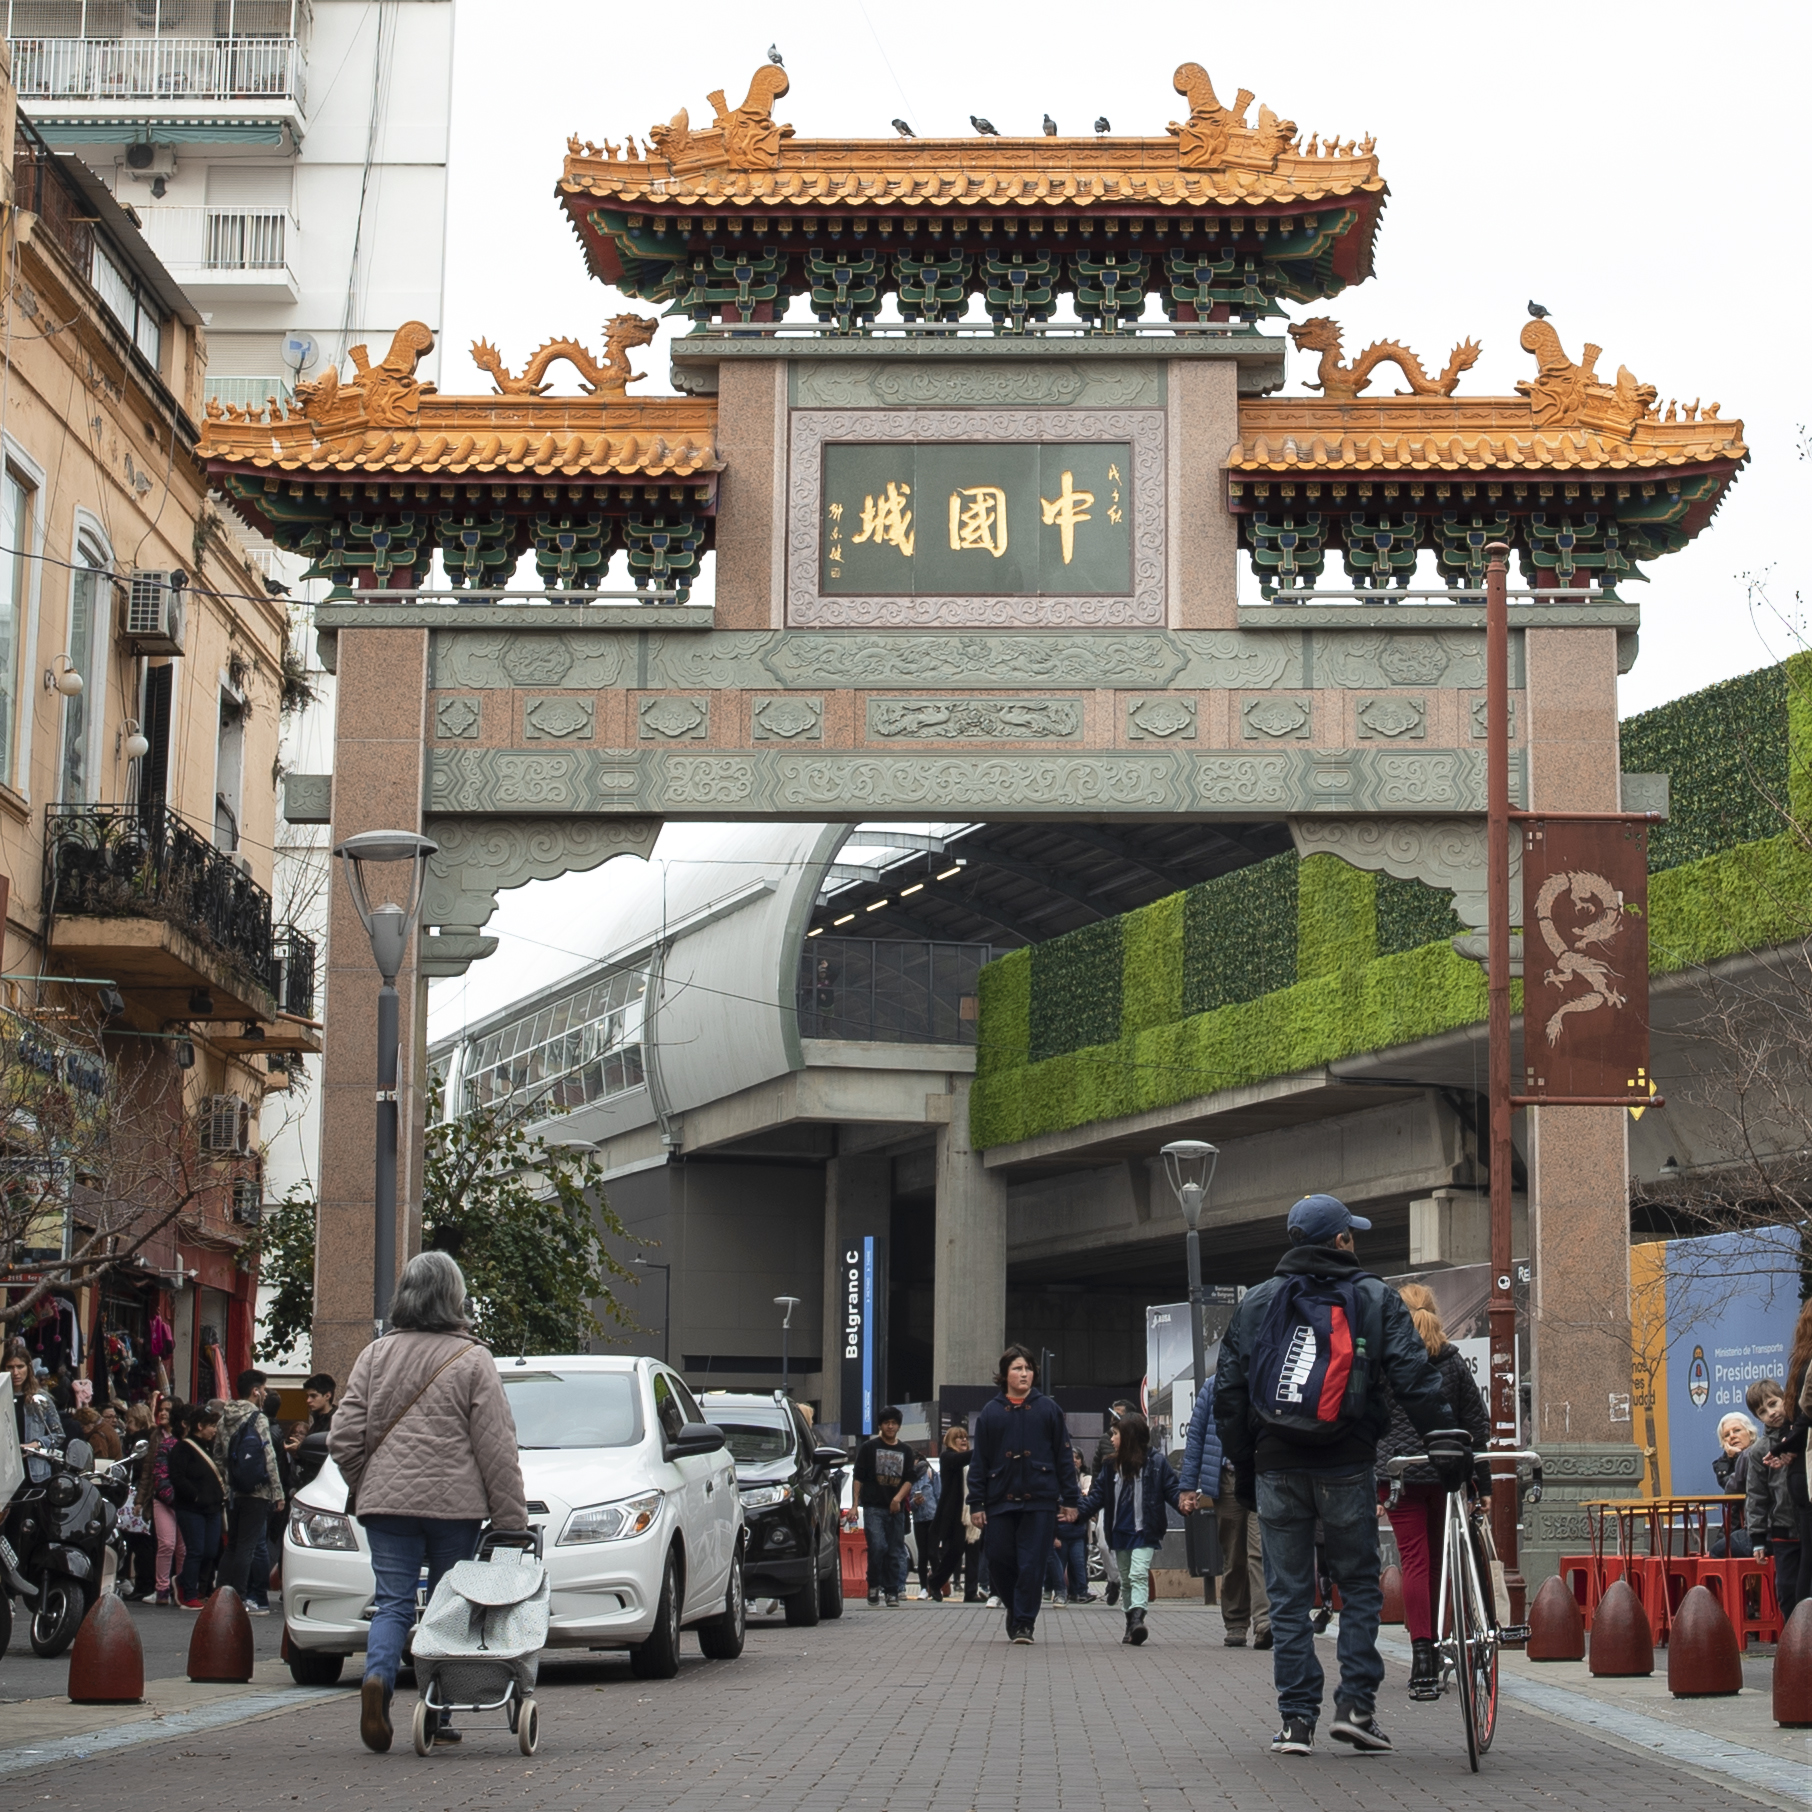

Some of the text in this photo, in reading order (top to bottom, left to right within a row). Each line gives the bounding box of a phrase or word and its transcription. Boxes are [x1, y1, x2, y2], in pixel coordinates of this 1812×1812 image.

[846, 1251, 861, 1358] Belgrano C
[1715, 1343, 1784, 1357] Ministerio de Transporte
[1715, 1359, 1784, 1382] Presidencia
[1716, 1386, 1730, 1405] de
[1733, 1385, 1743, 1403] la
